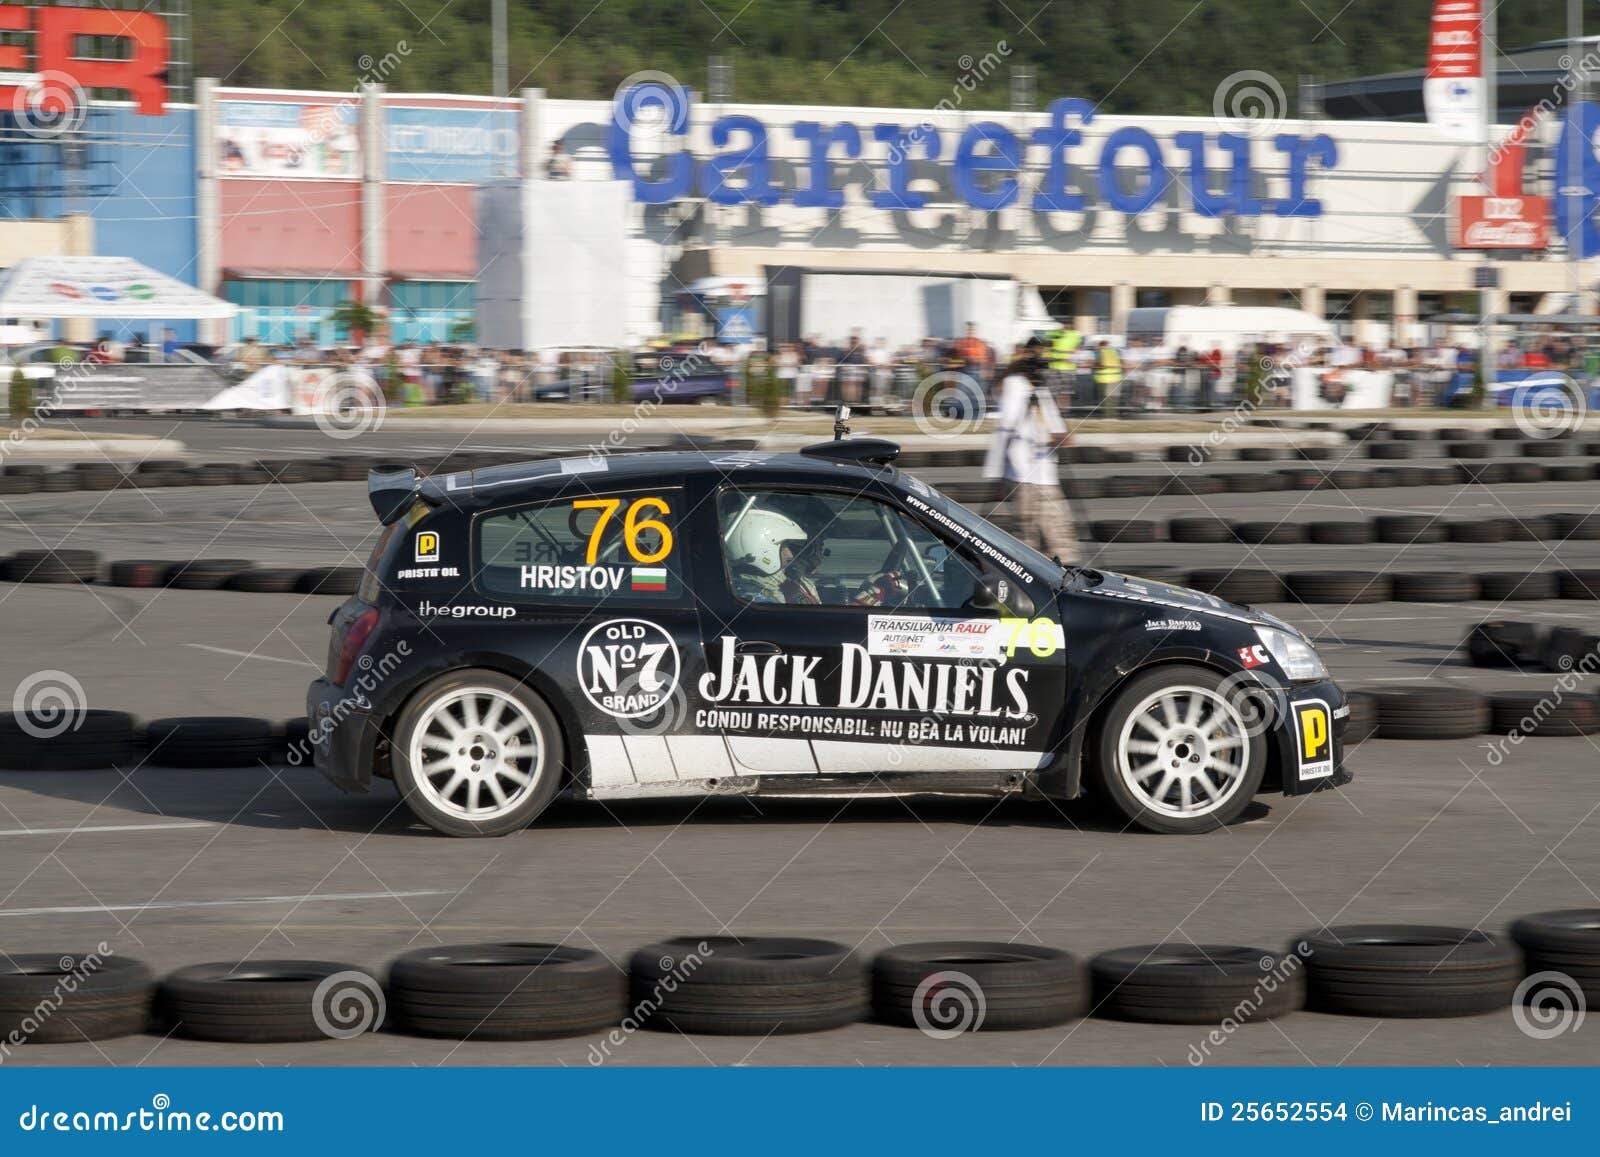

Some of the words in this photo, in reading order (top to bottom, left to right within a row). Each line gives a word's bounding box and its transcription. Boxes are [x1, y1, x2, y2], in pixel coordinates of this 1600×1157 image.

[610, 83, 1338, 217] Carrefour
[573, 497, 673, 565] 76
[905, 494, 1034, 584] www.consuma-responsabil.ro
[441, 567, 460, 577] OIL
[520, 565, 625, 590] HRISTOV
[419, 600, 516, 619] thegroup
[606, 624, 646, 640] OLD
[872, 619, 953, 633] TRANSILVANIA
[955, 623, 992, 634] RALLY
[1000, 617, 1057, 658] 76
[698, 636, 824, 706] JACK
[837, 642, 1031, 719] DANIEL'S
[602, 694, 660, 712] BRAND
[695, 709, 751, 730] CONDU
[758, 713, 875, 737] RESPONSABIL:
[880, 720, 903, 738] NU
[908, 721, 940, 741] BEA
[944, 724, 964, 742] LA
[969, 725, 1027, 746] VOLAN!
